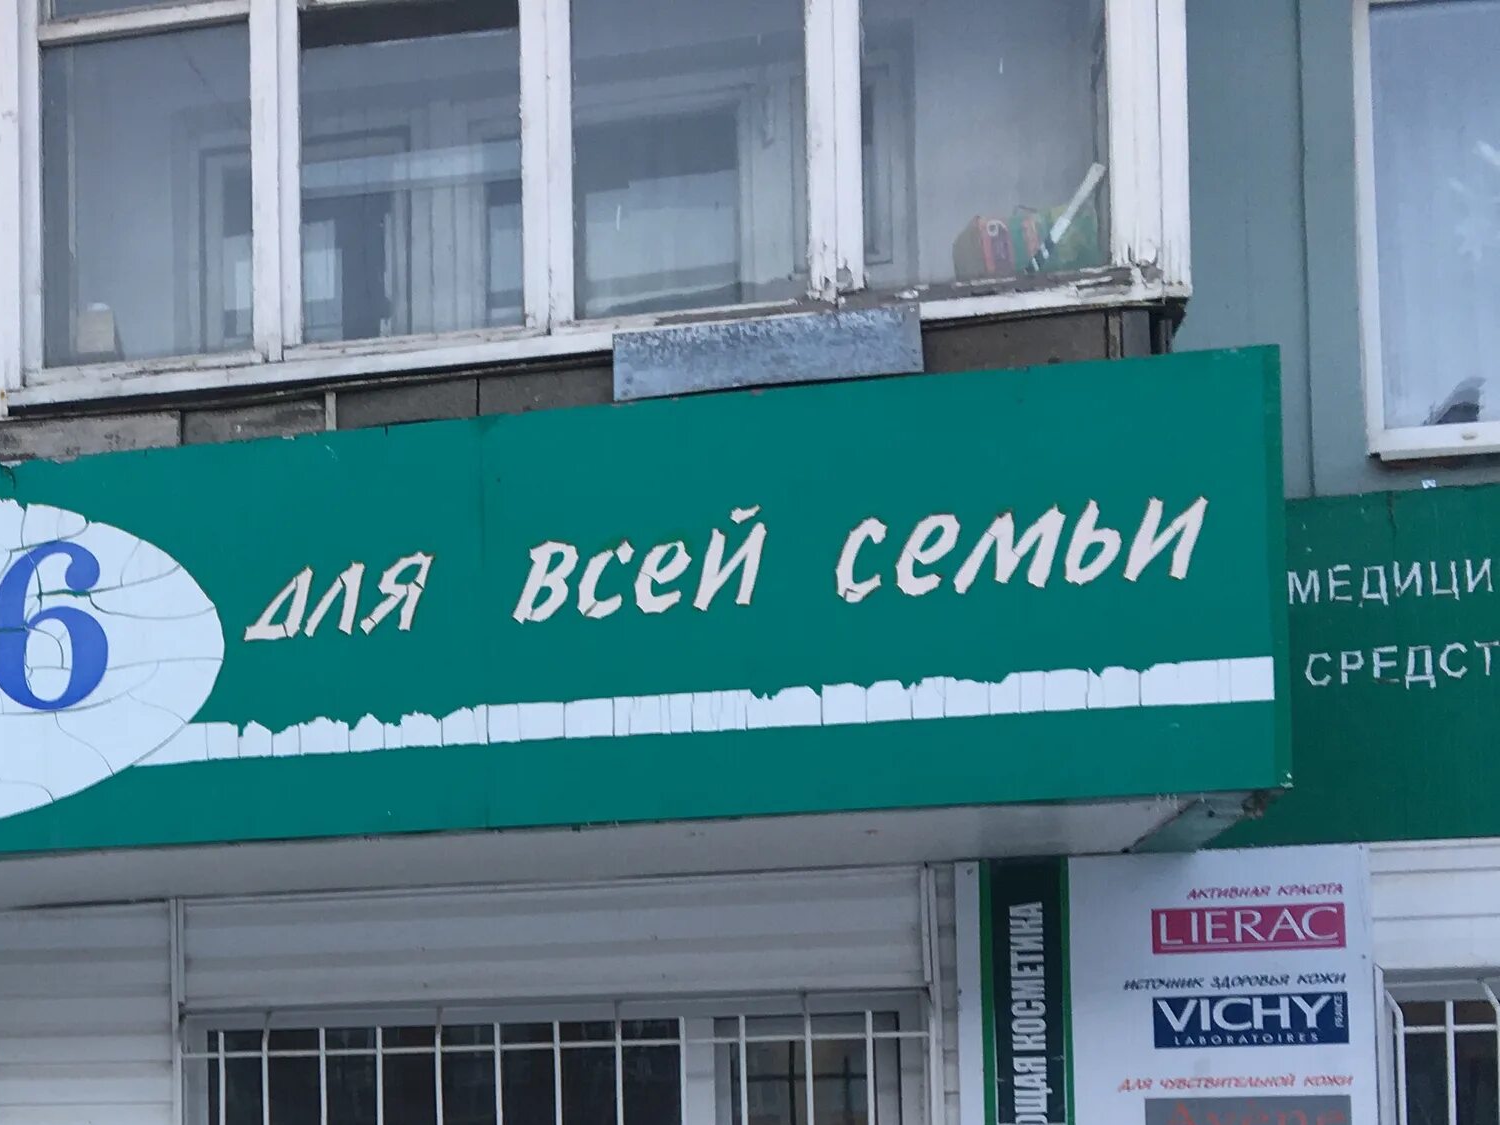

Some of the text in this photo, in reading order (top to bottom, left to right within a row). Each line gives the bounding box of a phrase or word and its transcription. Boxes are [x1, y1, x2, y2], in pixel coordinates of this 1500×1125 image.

[1287, 558, 1494, 609] МЕДИЦИ
[1304, 640, 1500, 690] СРЕДСТ
[1186, 885, 1271, 900] АКТИВНАЯ
[1159, 906, 1339, 944] LIERAC
[1008, 901, 1046, 1051] КОСМЕТИКА
[1122, 972, 1347, 992] ИСТОЧНИК ЗДОРОВЬЯ КОЖИ
[1155, 994, 1332, 1031] VICHY
[1173, 1030, 1320, 1046] LABORATOIRES
[1117, 1073, 1354, 1093] ДЛЯ ЧУВСТВИТЕЛЬНОЙ КОЖИ
